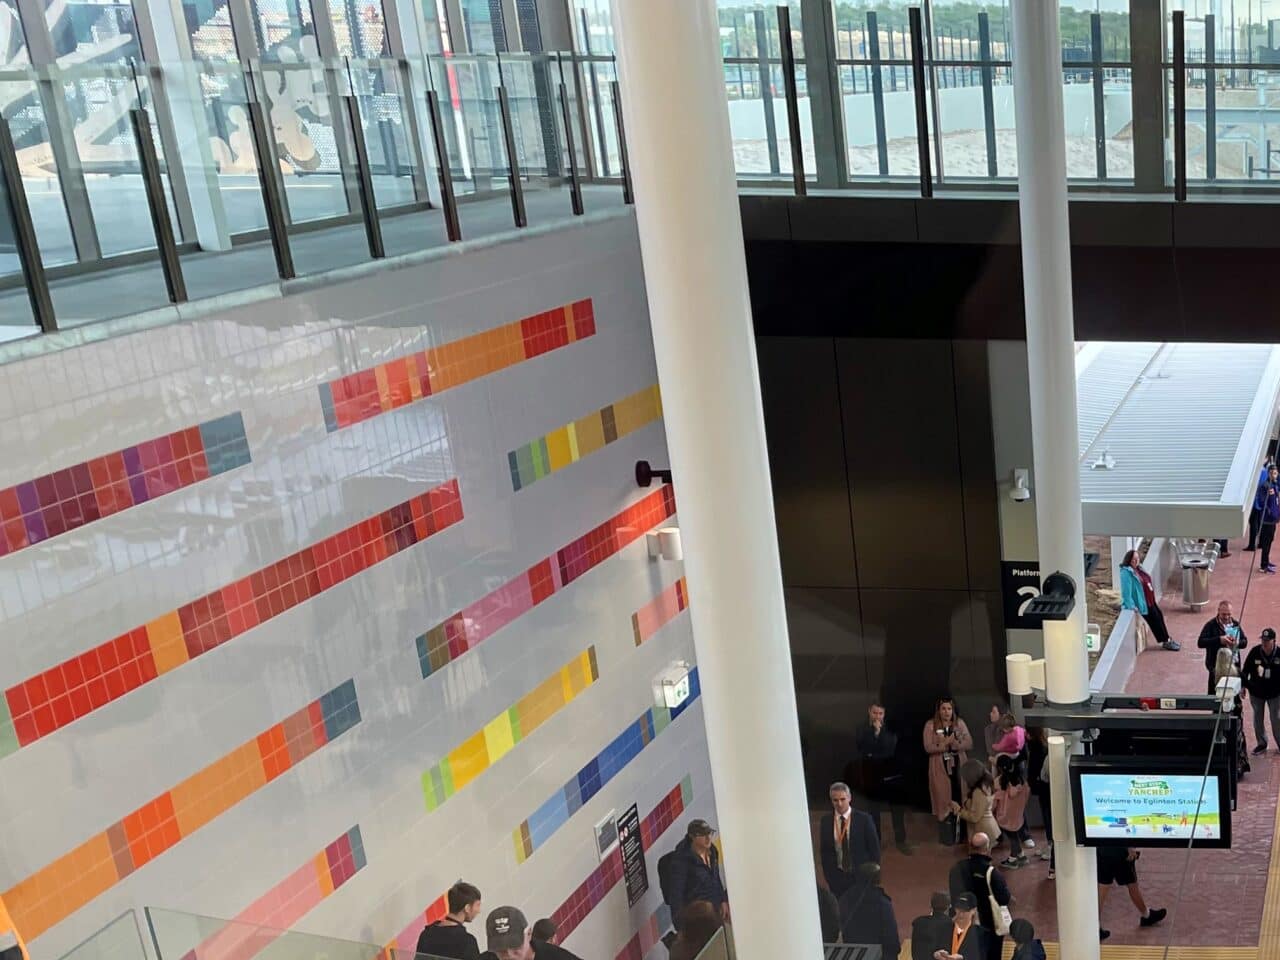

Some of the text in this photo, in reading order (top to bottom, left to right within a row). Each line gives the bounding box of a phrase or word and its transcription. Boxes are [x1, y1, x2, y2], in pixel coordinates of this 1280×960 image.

[1095, 797, 1131, 805] Welcome
[1133, 797, 1142, 805] to
[1143, 797, 1177, 806] Eglinton
